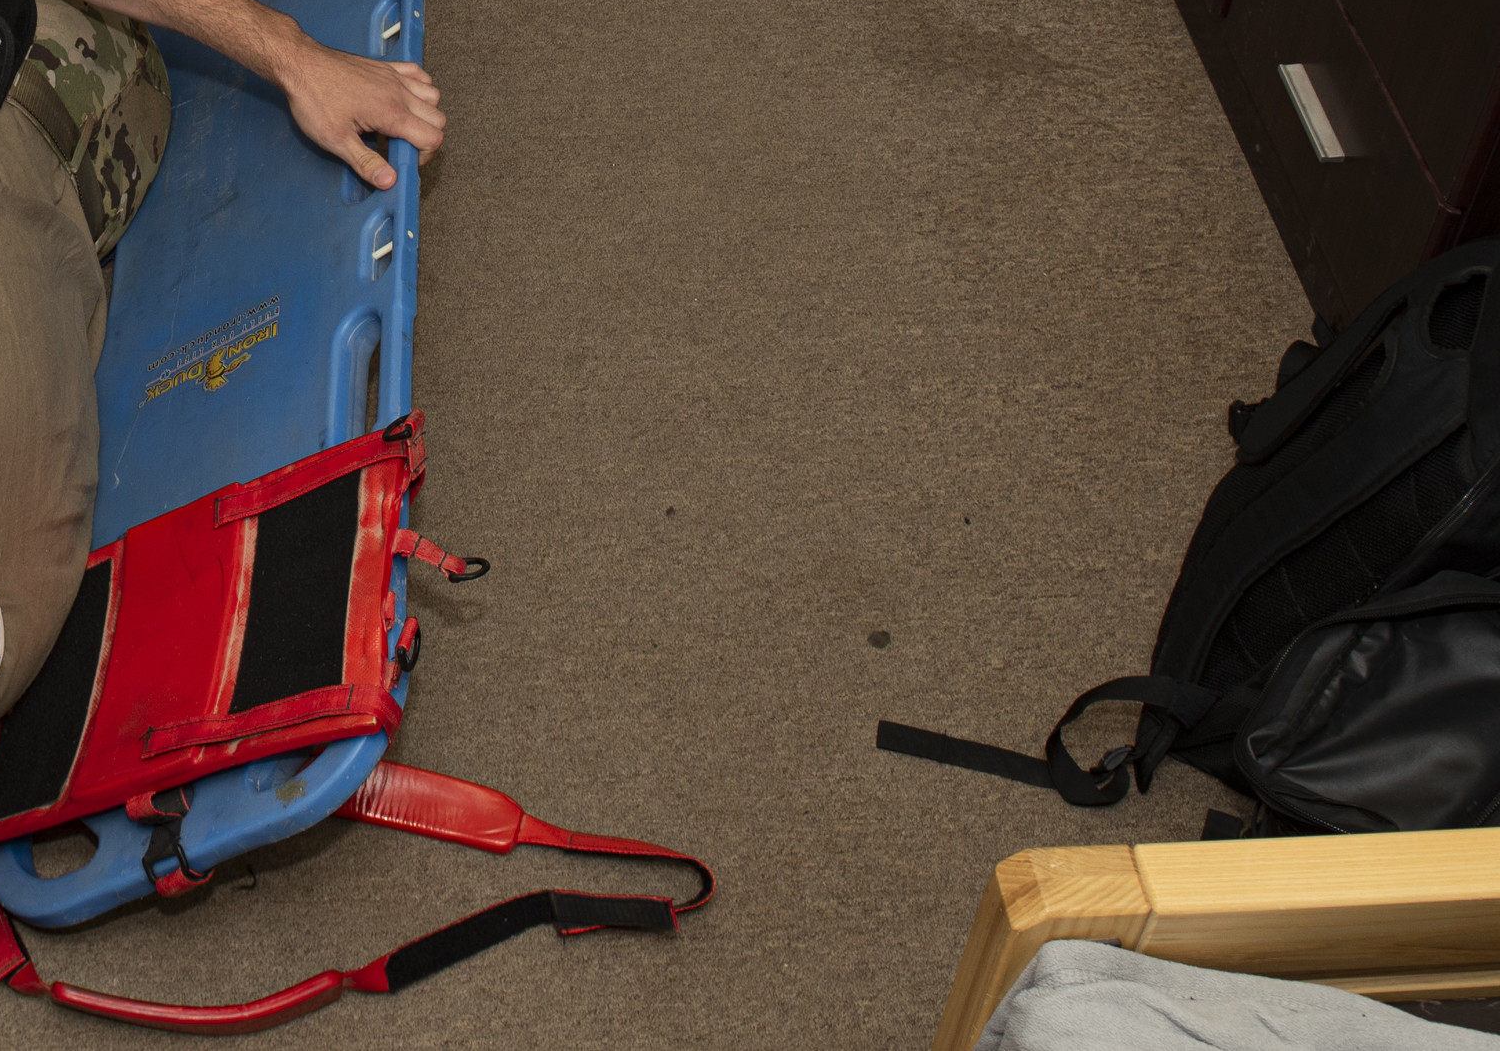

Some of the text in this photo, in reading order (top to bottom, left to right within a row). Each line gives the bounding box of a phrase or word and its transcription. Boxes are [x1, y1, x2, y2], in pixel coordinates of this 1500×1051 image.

[145, 321, 278, 402] IRON DUCK
[147, 295, 280, 371] www.ironduck.com
